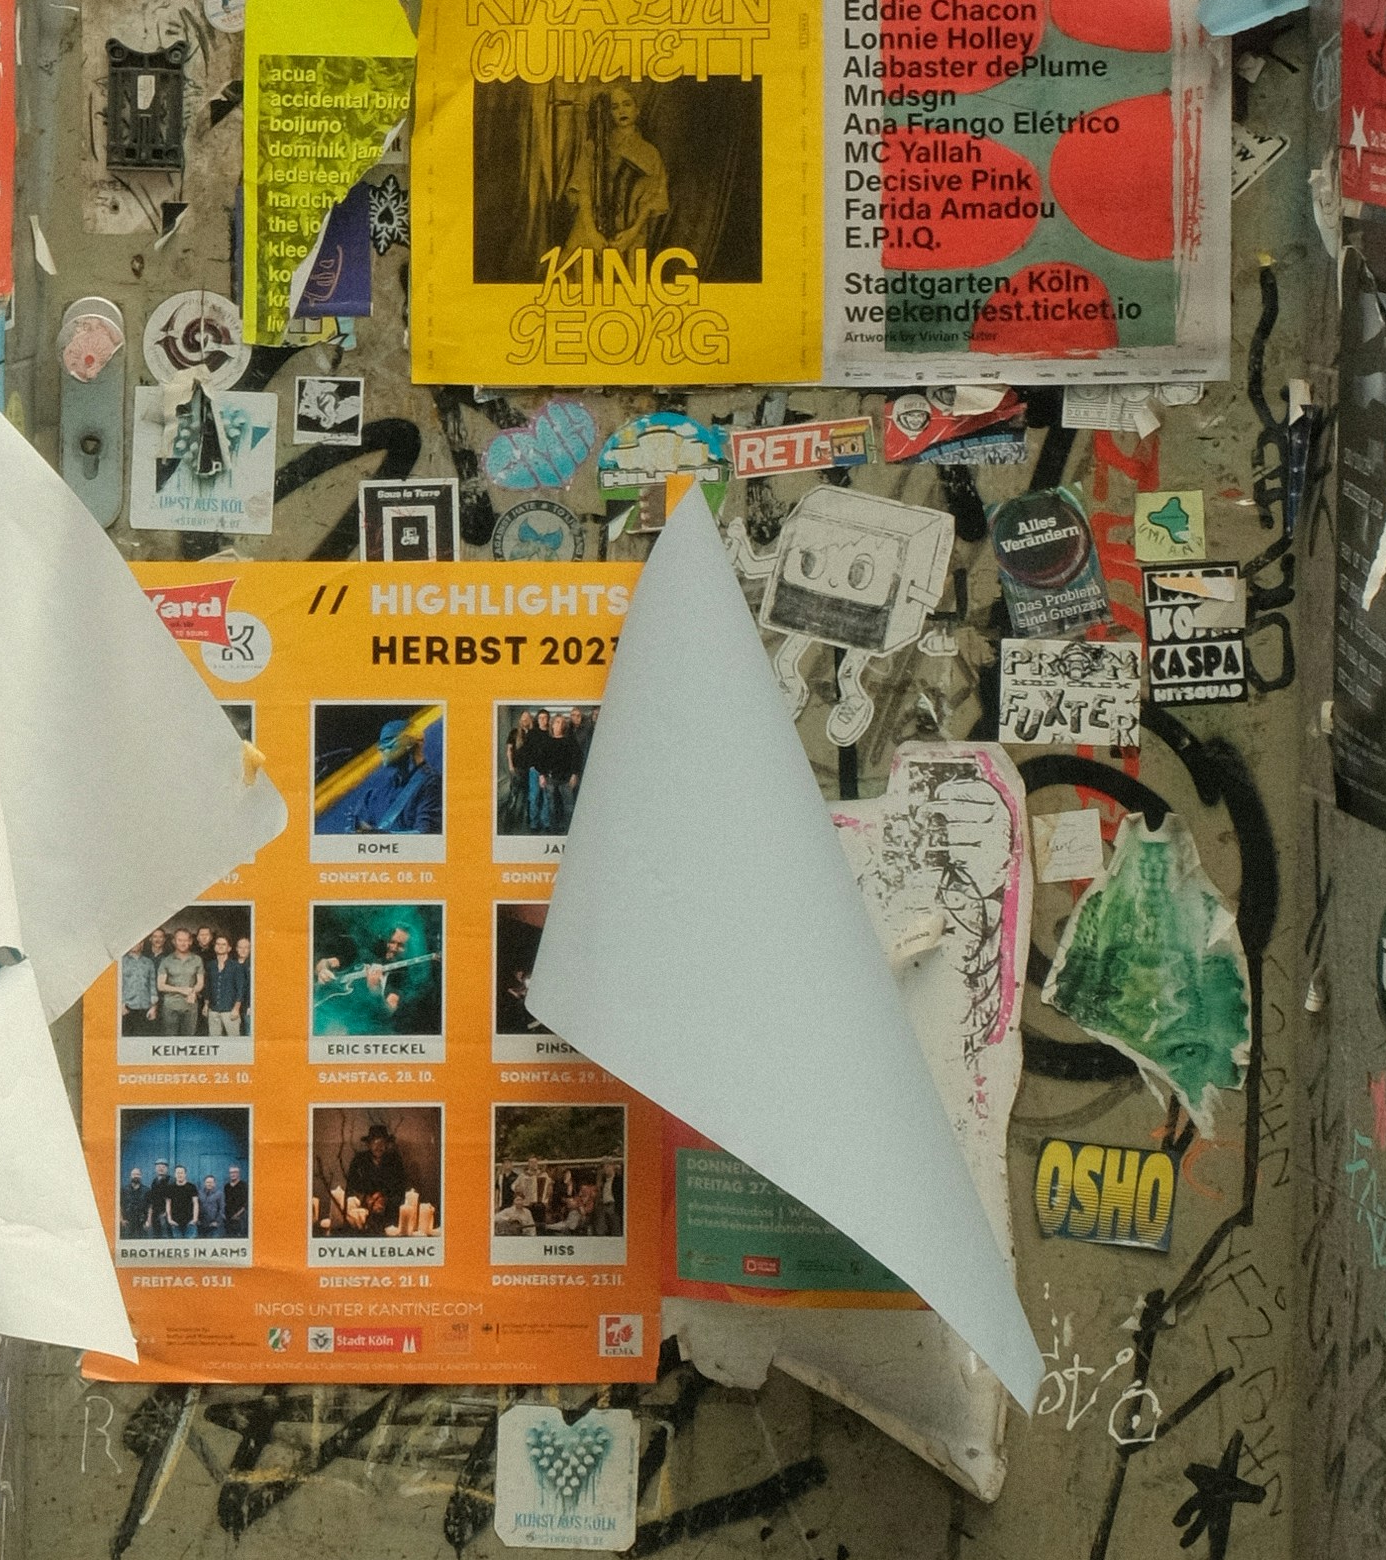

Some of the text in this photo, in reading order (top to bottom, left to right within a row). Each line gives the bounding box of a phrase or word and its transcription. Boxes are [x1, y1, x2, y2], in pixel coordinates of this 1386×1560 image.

[844, 0, 1037, 21] Eddie Chacon
[469, 28, 769, 84] QUINTETT
[270, 68, 315, 83] acua
[843, 56, 1108, 78] Alabaster dePlume
[270, 91, 370, 109] accidental
[844, 228, 941, 251] E.P.I.Q.
[539, 248, 699, 306] KING
[844, 269, 1089, 300] Stadtgarten, Köln
[844, 300, 1142, 323] weekendfest.ticket.io
[508, 307, 730, 366] GEORG
[1018, 513, 1056, 533] Alles
[1001, 523, 1078, 552] Verändern
[371, 585, 630, 615] HIGHLIGHTS
[373, 636, 527, 665] HERBST
[1152, 647, 1242, 679] CASPA
[1153, 685, 1242, 702] HITSQUAD
[358, 843, 400, 854] ROME
[151, 1045, 219, 1057] KEIMZEIT
[328, 1043, 426, 1055] ERIC STECKEL
[1036, 1141, 1175, 1243] OSHO
[121, 1247, 247, 1259] BROTHERS IN ARMS
[318, 1245, 435, 1259] DYLAN LEBLANC
[543, 1244, 575, 1256] HISS
[336, 1334, 394, 1347] Stadt Köln
